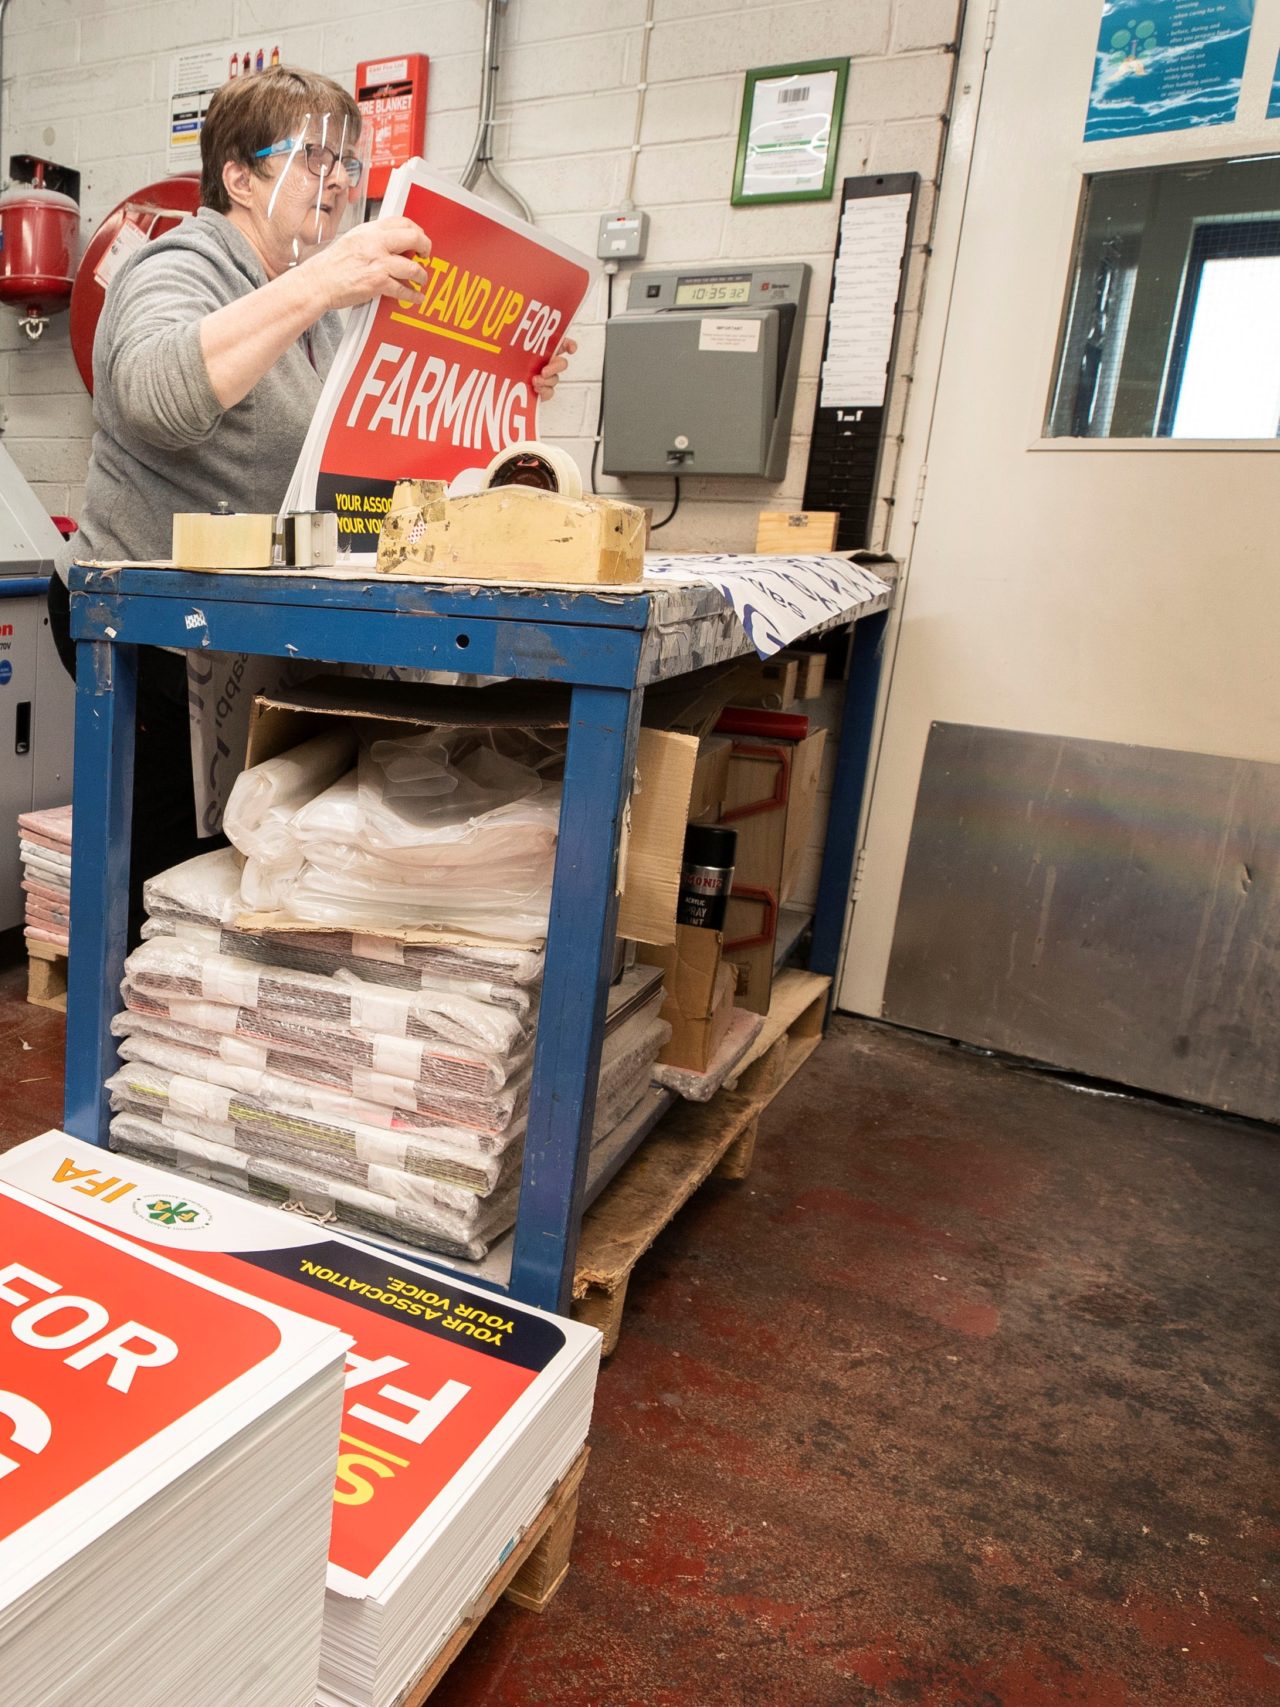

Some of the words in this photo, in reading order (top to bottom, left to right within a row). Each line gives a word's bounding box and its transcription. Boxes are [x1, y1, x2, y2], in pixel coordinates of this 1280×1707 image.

[375, 95, 412, 113] BLANKET
[481, 286, 525, 340] UP
[510, 299, 562, 357] FOR
[346, 342, 528, 452] FARMING
[335, 493, 362, 511] YOUR
[337, 517, 366, 534] YOUR
[52, 1157, 138, 1203] IFA
[299, 1259, 443, 1321] ASSOCIATION.
[386, 1276, 450, 1310] VOICE.
[441, 1315, 504, 1346] YOUR
[454, 1303, 515, 1334] YOUR
